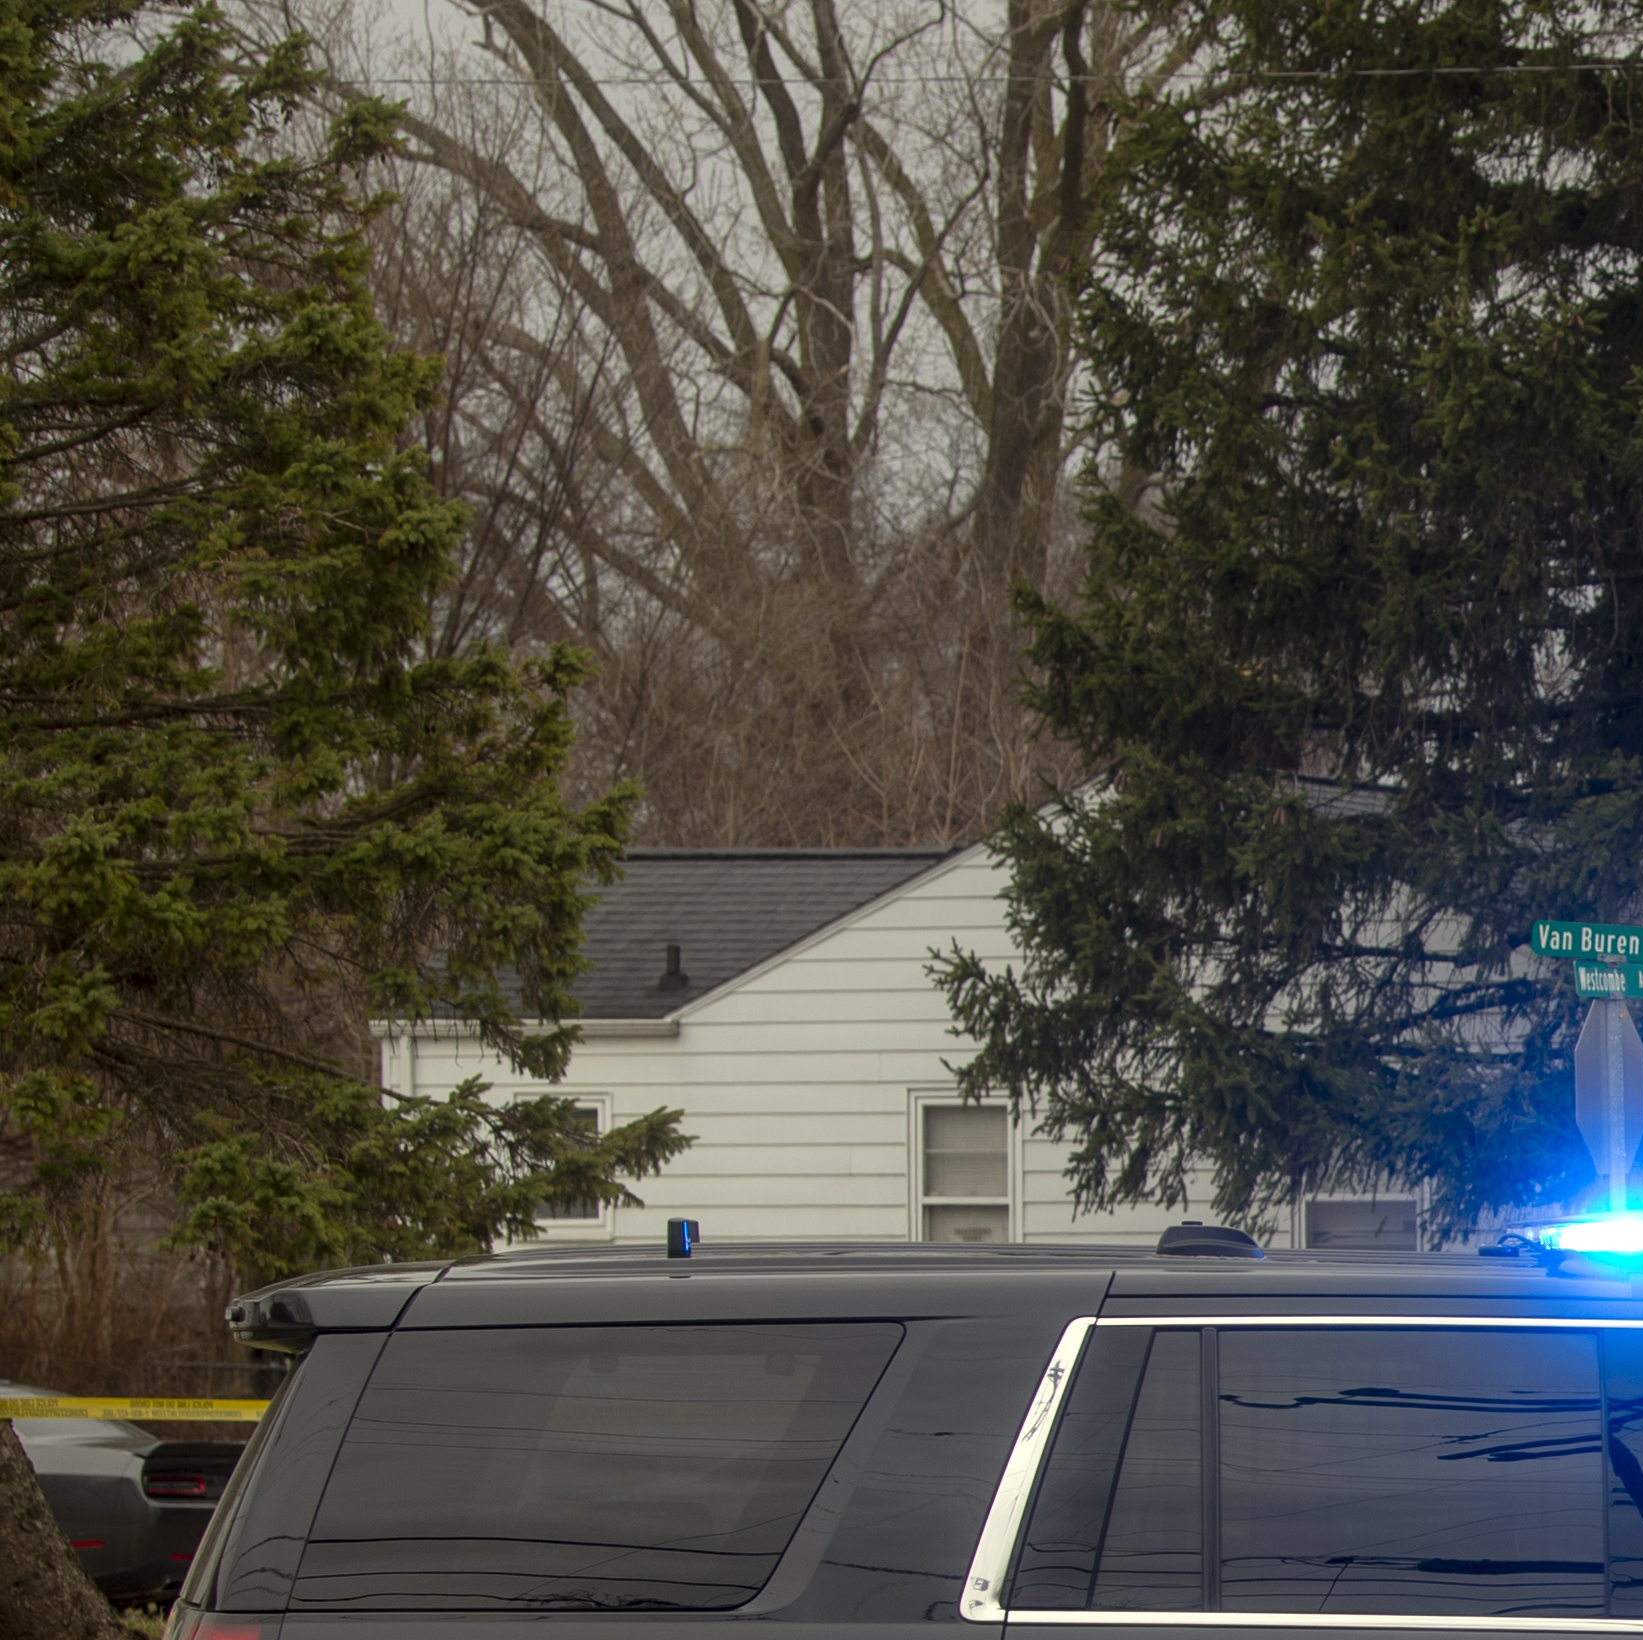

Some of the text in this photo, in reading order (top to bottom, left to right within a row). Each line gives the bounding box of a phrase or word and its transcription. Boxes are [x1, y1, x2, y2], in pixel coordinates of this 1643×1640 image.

[1538, 923, 1572, 950] Van
[1581, 927, 1640, 955] Buren
[1578, 966, 1626, 992] Westcombe
